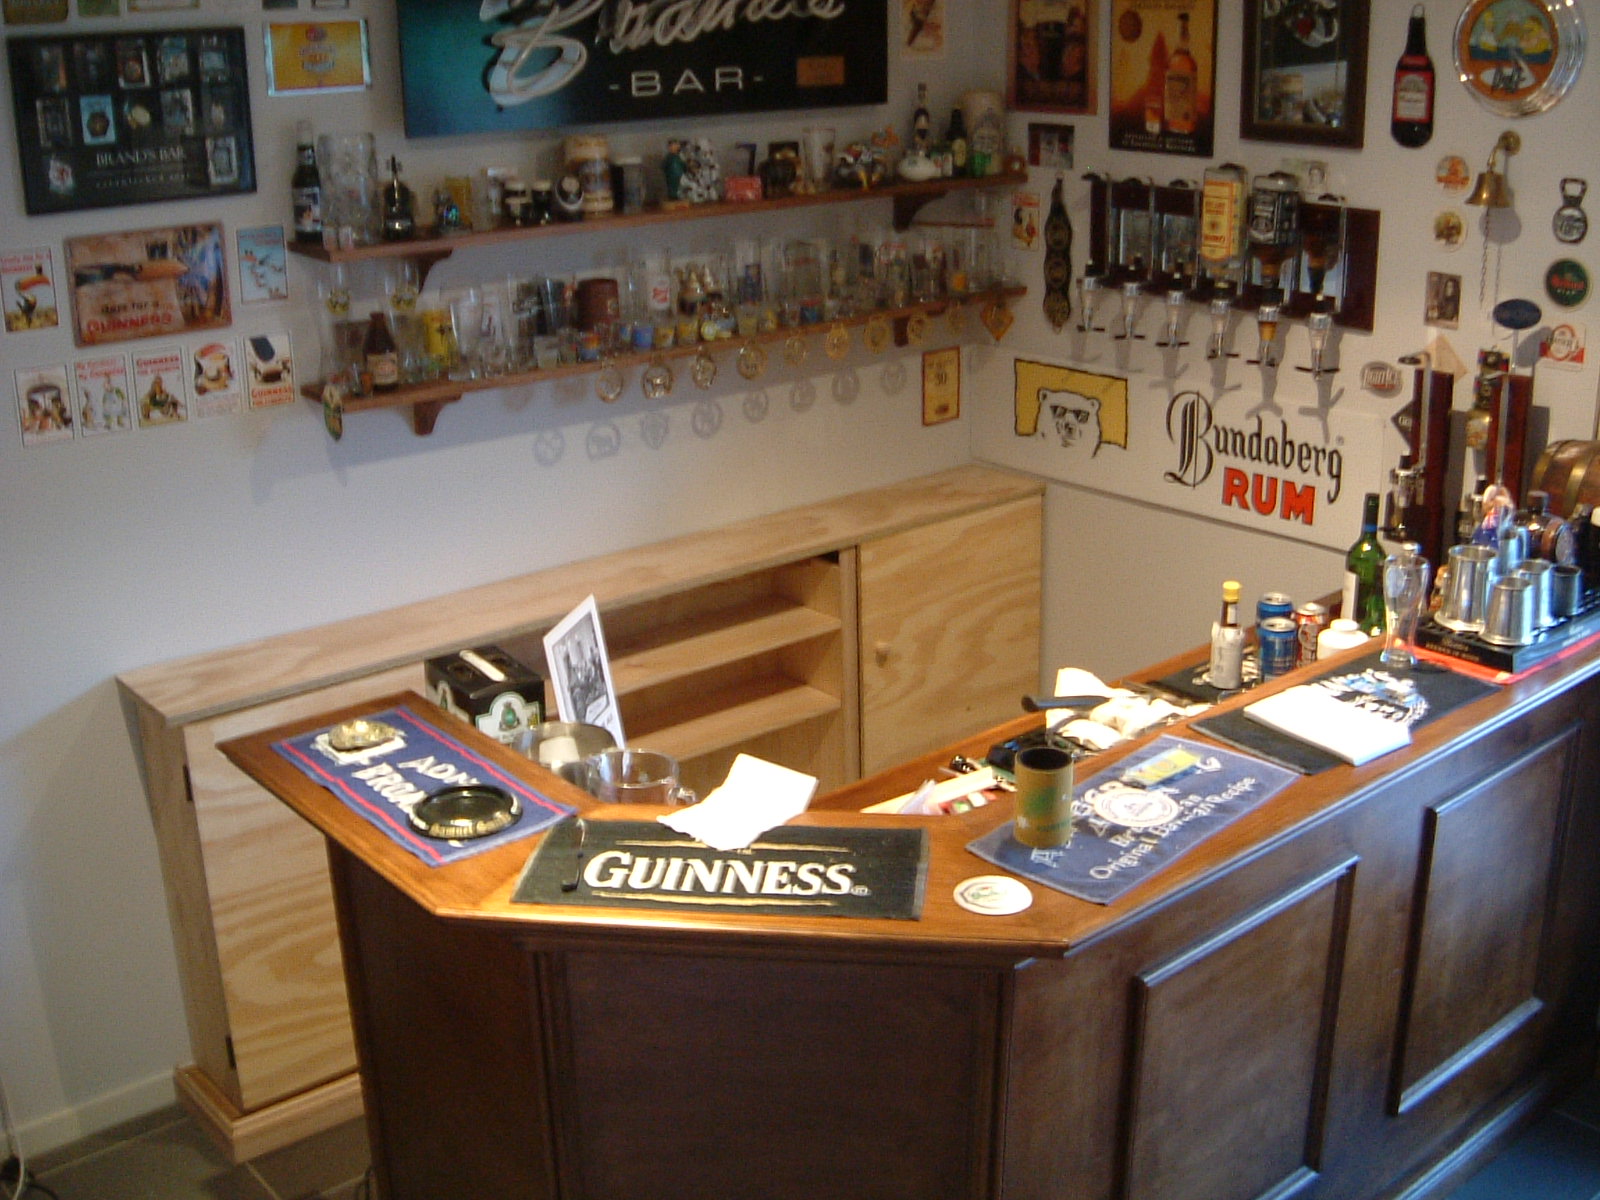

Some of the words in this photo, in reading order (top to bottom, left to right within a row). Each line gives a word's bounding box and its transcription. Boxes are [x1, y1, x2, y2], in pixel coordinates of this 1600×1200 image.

[1164, 390, 1343, 504] Bundaberg
[1221, 466, 1316, 526] RUM
[583, 850, 857, 896] GUINNESS
